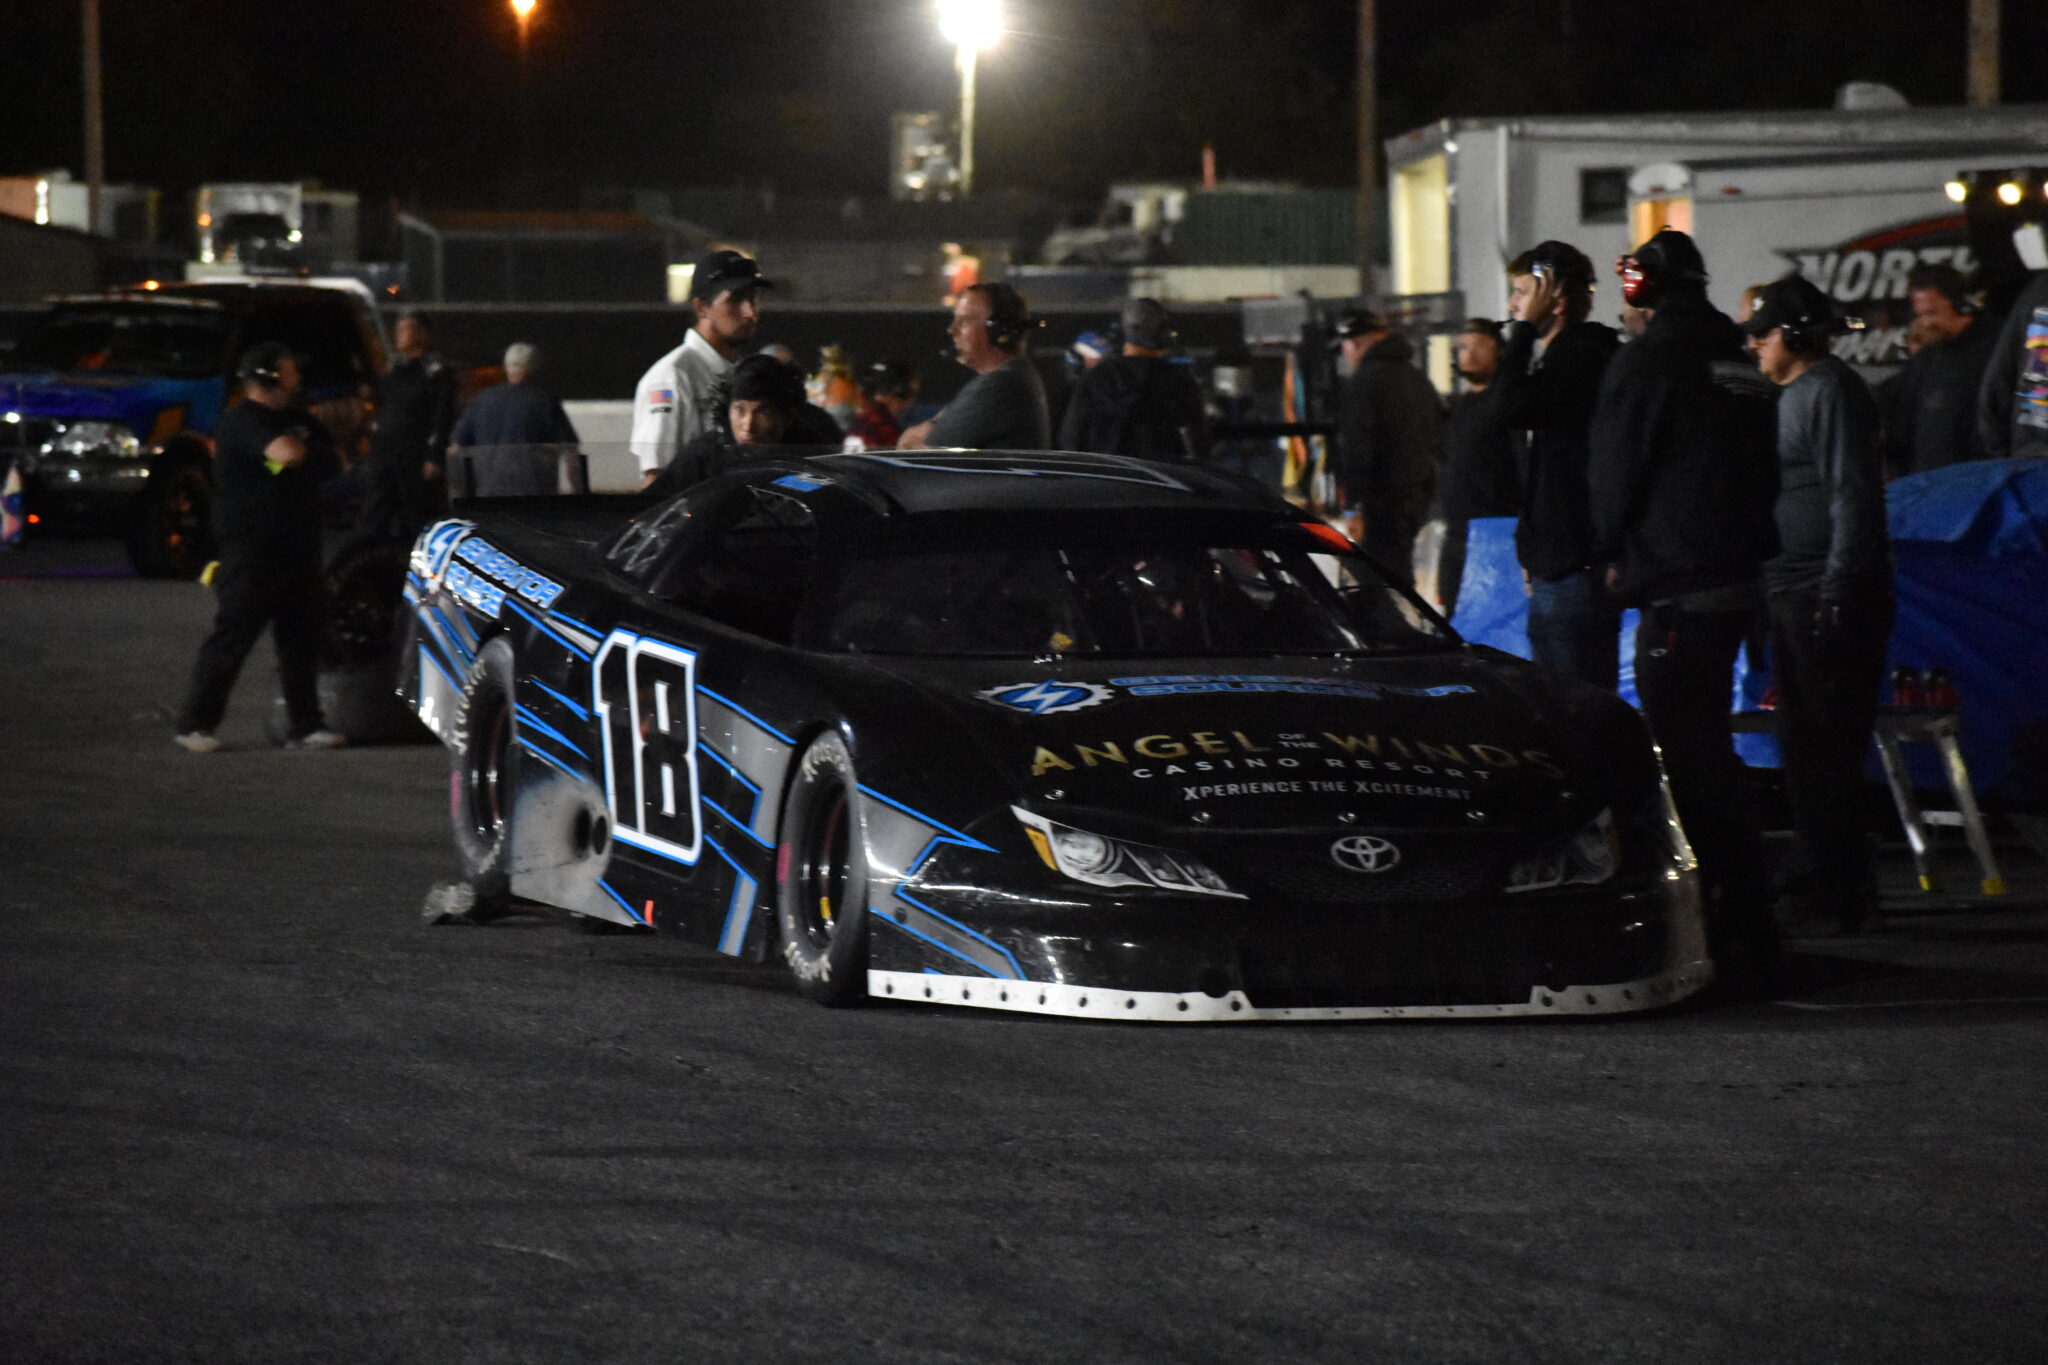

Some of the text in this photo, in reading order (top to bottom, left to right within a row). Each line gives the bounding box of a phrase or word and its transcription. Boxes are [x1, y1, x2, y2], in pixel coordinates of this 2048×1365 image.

[592, 626, 702, 866] 18
[1278, 732, 1306, 740] OF
[1278, 740, 1321, 749] THE
[1030, 730, 1271, 777] ANGEL
[1321, 730, 1566, 780] WINDS
[1131, 757, 1491, 780] CASINO RESORT
[1183, 780, 1473, 801] XPERIENCE THE XCITEMENT
